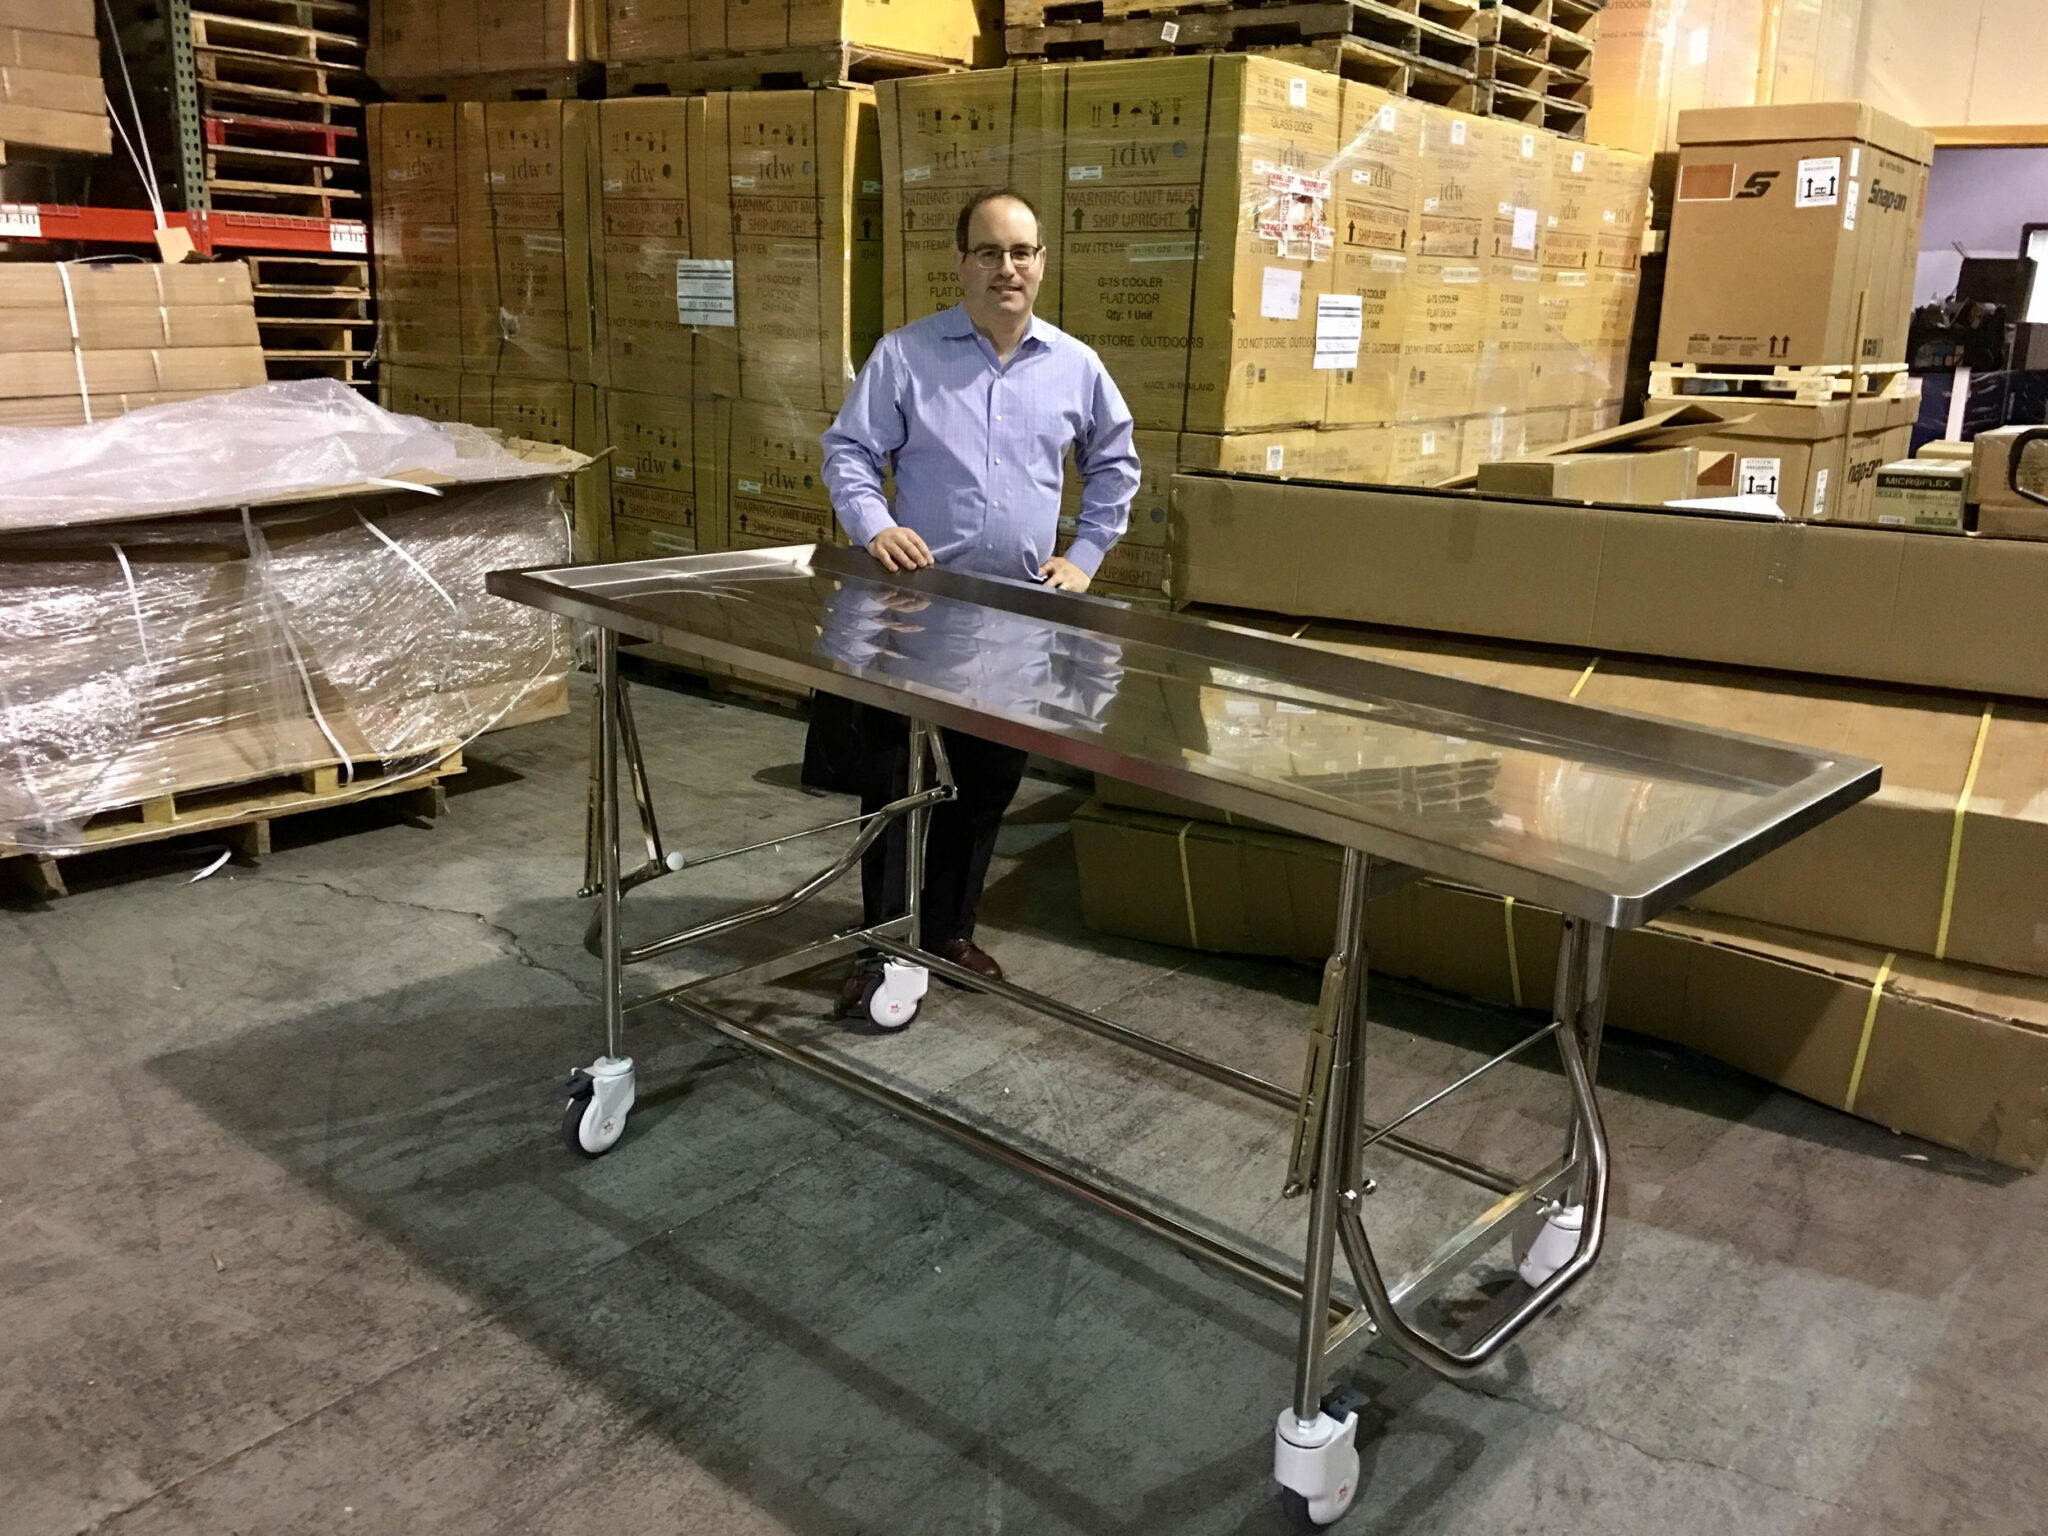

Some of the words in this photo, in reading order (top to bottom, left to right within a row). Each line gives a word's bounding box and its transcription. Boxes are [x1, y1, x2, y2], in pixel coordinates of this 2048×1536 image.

[934, 142, 980, 171] idw
[1109, 138, 1160, 169] idw
[511, 157, 541, 181] idw
[625, 160, 656, 184] idw
[760, 155, 795, 181] idw
[1066, 191, 1131, 207] WARNING:
[1133, 190, 1163, 205] UNIT
[1868, 179, 1907, 214] Snap-on
[777, 201, 798, 214] UNIT
[801, 202, 825, 215] MUT
[749, 218, 768, 232] SHIP
[770, 219, 808, 234] UPRIGHT
[921, 213, 944, 226] SHIP
[1093, 213, 1119, 228] SHIP
[1122, 212, 1176, 228] UPRIGHT
[1070, 243, 1091, 254] IDW
[928, 271, 947, 282] G-7S
[1098, 277, 1120, 288] G-7S
[1122, 277, 1164, 288] COOLER
[929, 286, 951, 298] FLAT
[1100, 293, 1125, 304] FLAT
[1127, 292, 1160, 304] DOOR
[1106, 309, 1124, 321] Qty:
[1134, 309, 1153, 320] Unit
[1099, 335, 1136, 347] STORE
[1238, 337, 1248, 349] DO
[1250, 337, 1264, 349] NOT
[1264, 337, 1287, 349] STORE
[636, 451, 667, 475] idw
[762, 466, 798, 490] idw
[1847, 458, 1883, 488] nap-on
[780, 508, 800, 521] UNIT
[801, 510, 828, 527] MUST
[1103, 564, 1153, 585] UPRIGHT
